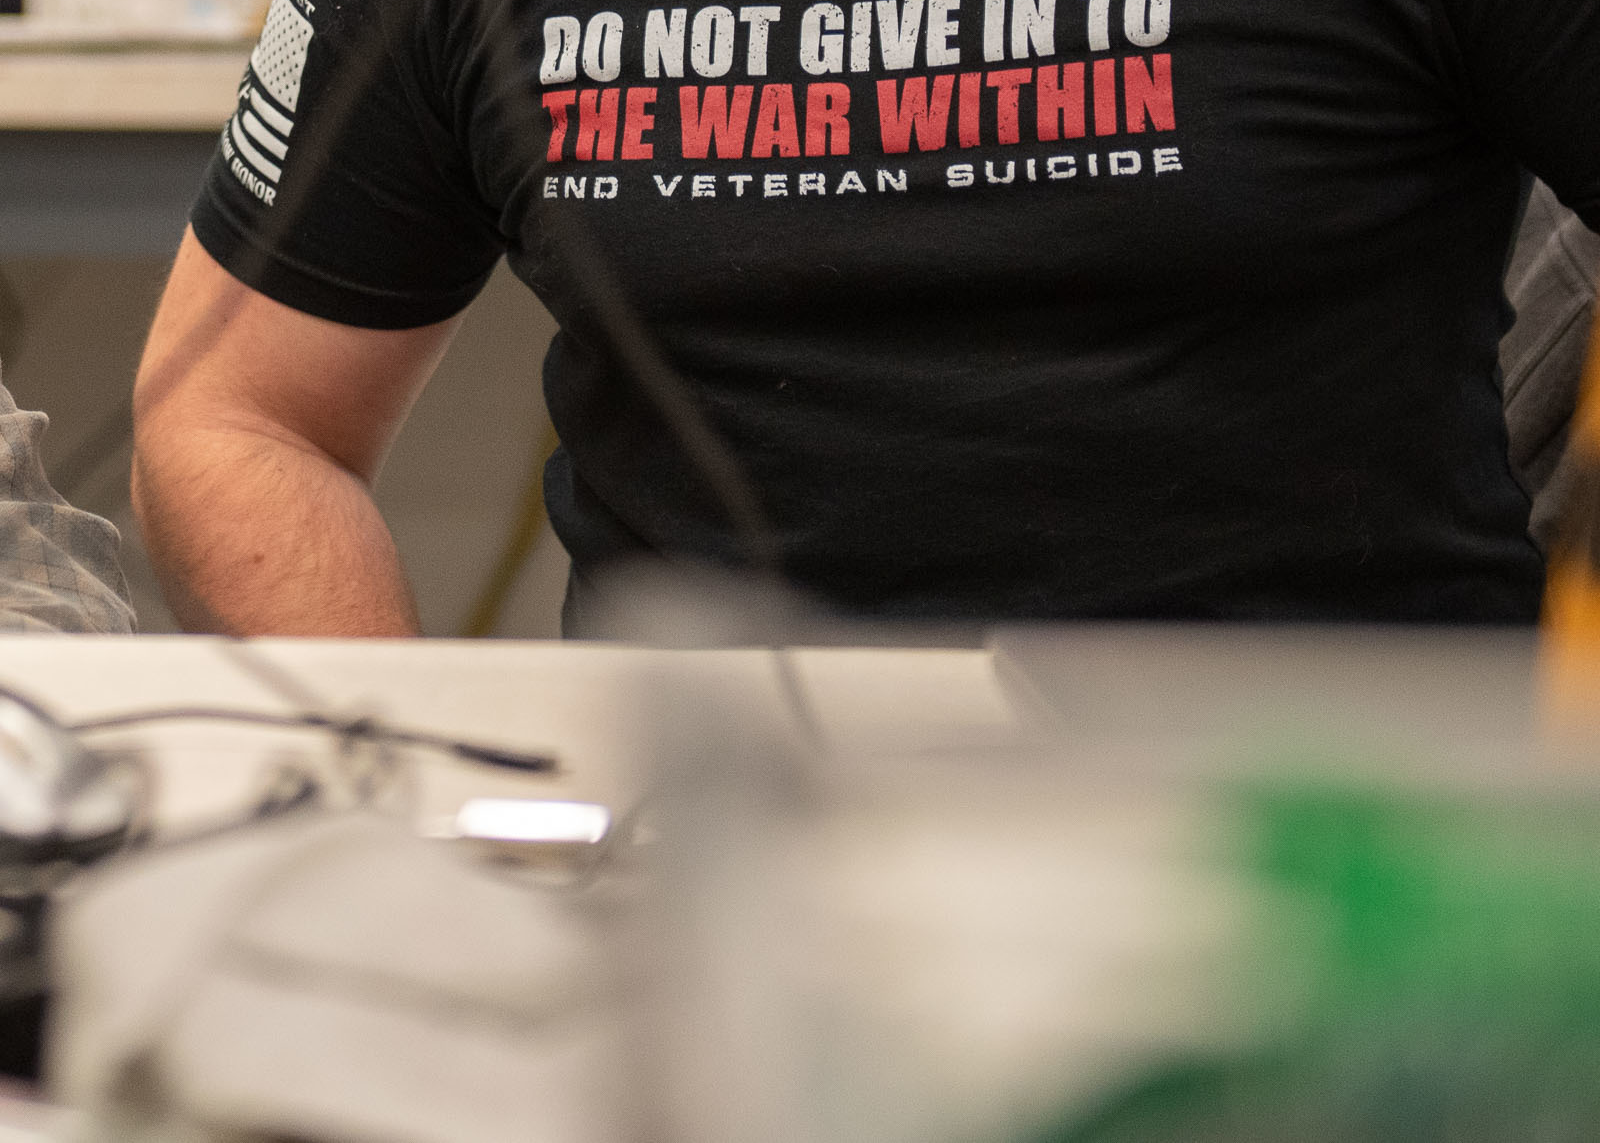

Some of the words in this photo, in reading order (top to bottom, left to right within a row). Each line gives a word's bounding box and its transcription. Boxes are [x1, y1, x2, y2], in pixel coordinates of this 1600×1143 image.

[540, 11, 623, 84] DO
[644, 6, 781, 78] NOT
[542, 87, 657, 161] THE
[679, 82, 850, 159] WAR
[877, 54, 1175, 153] WITHIN
[231, 157, 277, 207] HONOR
[544, 176, 618, 199] END
[653, 169, 907, 198] VETERAN
[946, 147, 1183, 187] SUICIDE
